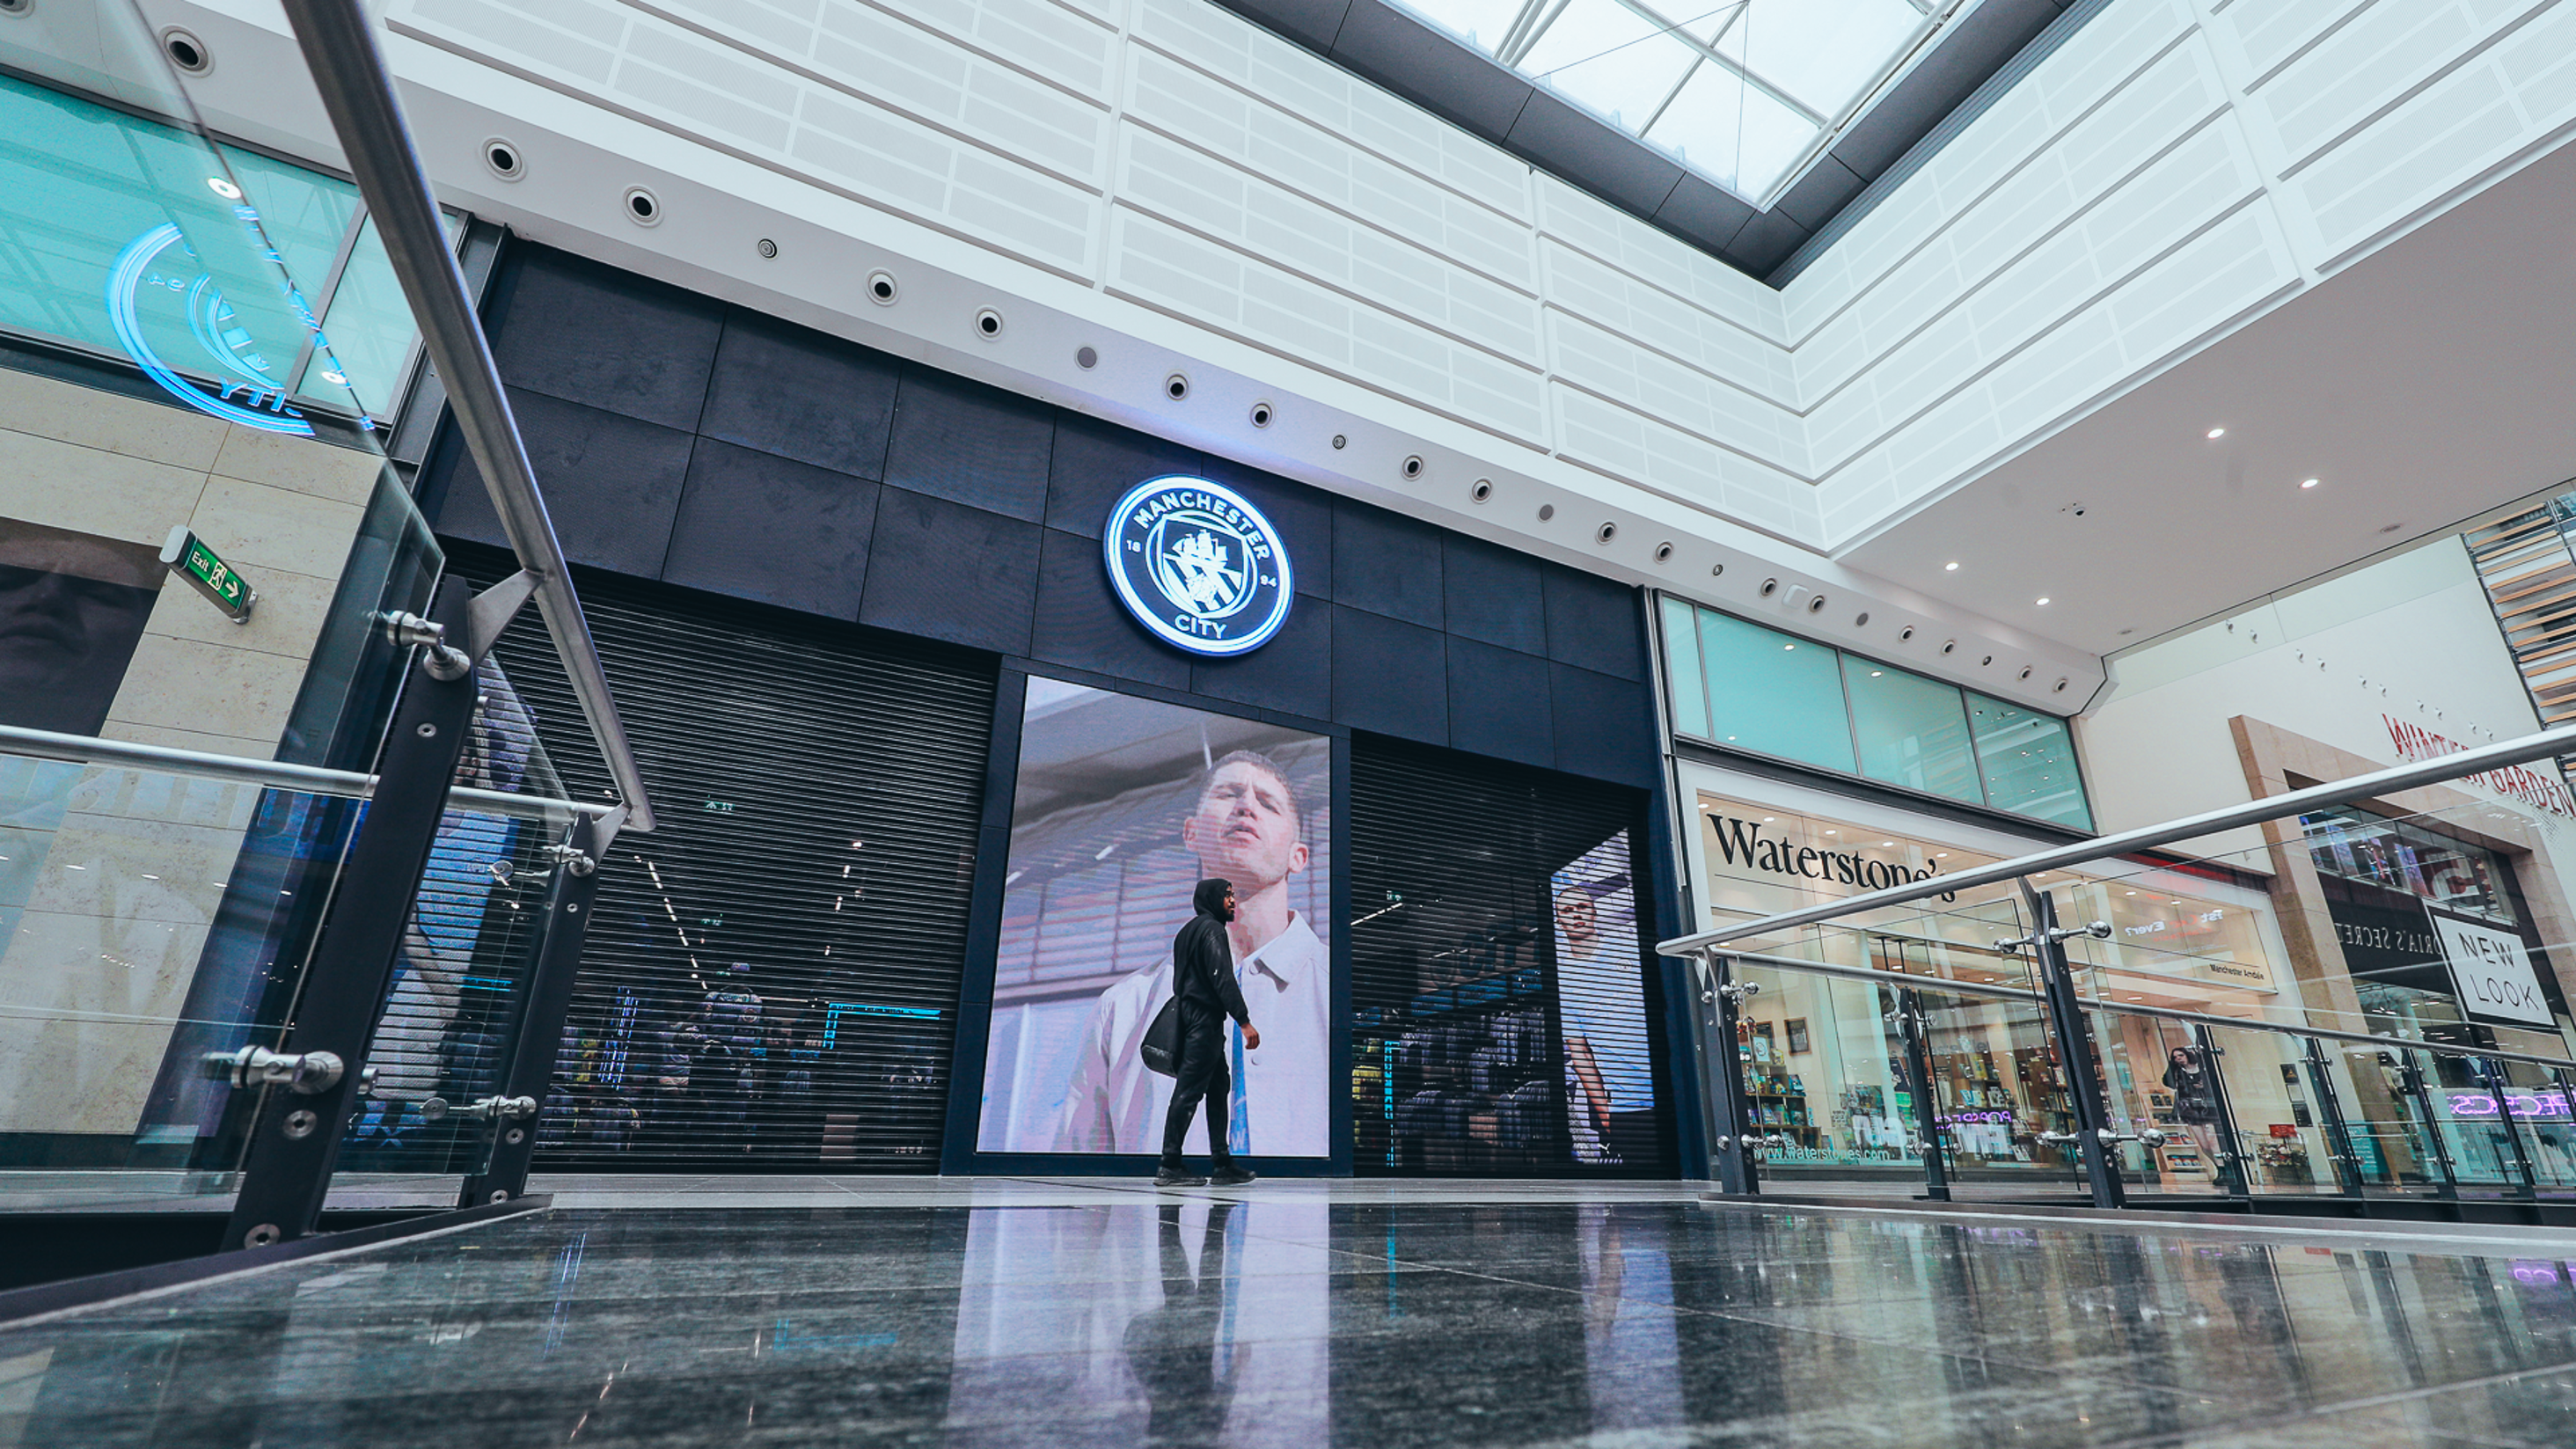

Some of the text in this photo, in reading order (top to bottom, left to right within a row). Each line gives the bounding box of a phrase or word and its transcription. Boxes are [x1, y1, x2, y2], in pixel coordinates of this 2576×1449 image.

[1133, 492, 1270, 560] MANCHESTER
[1126, 538, 1142, 553] 18
[191, 551, 209, 572] Exit
[1260, 574, 1277, 588] 94
[1175, 614, 1227, 639] CITY
[2382, 714, 2486, 786] WINT
[2458, 933, 2515, 968] NEW
[2470, 974, 2539, 1011] LOOK
